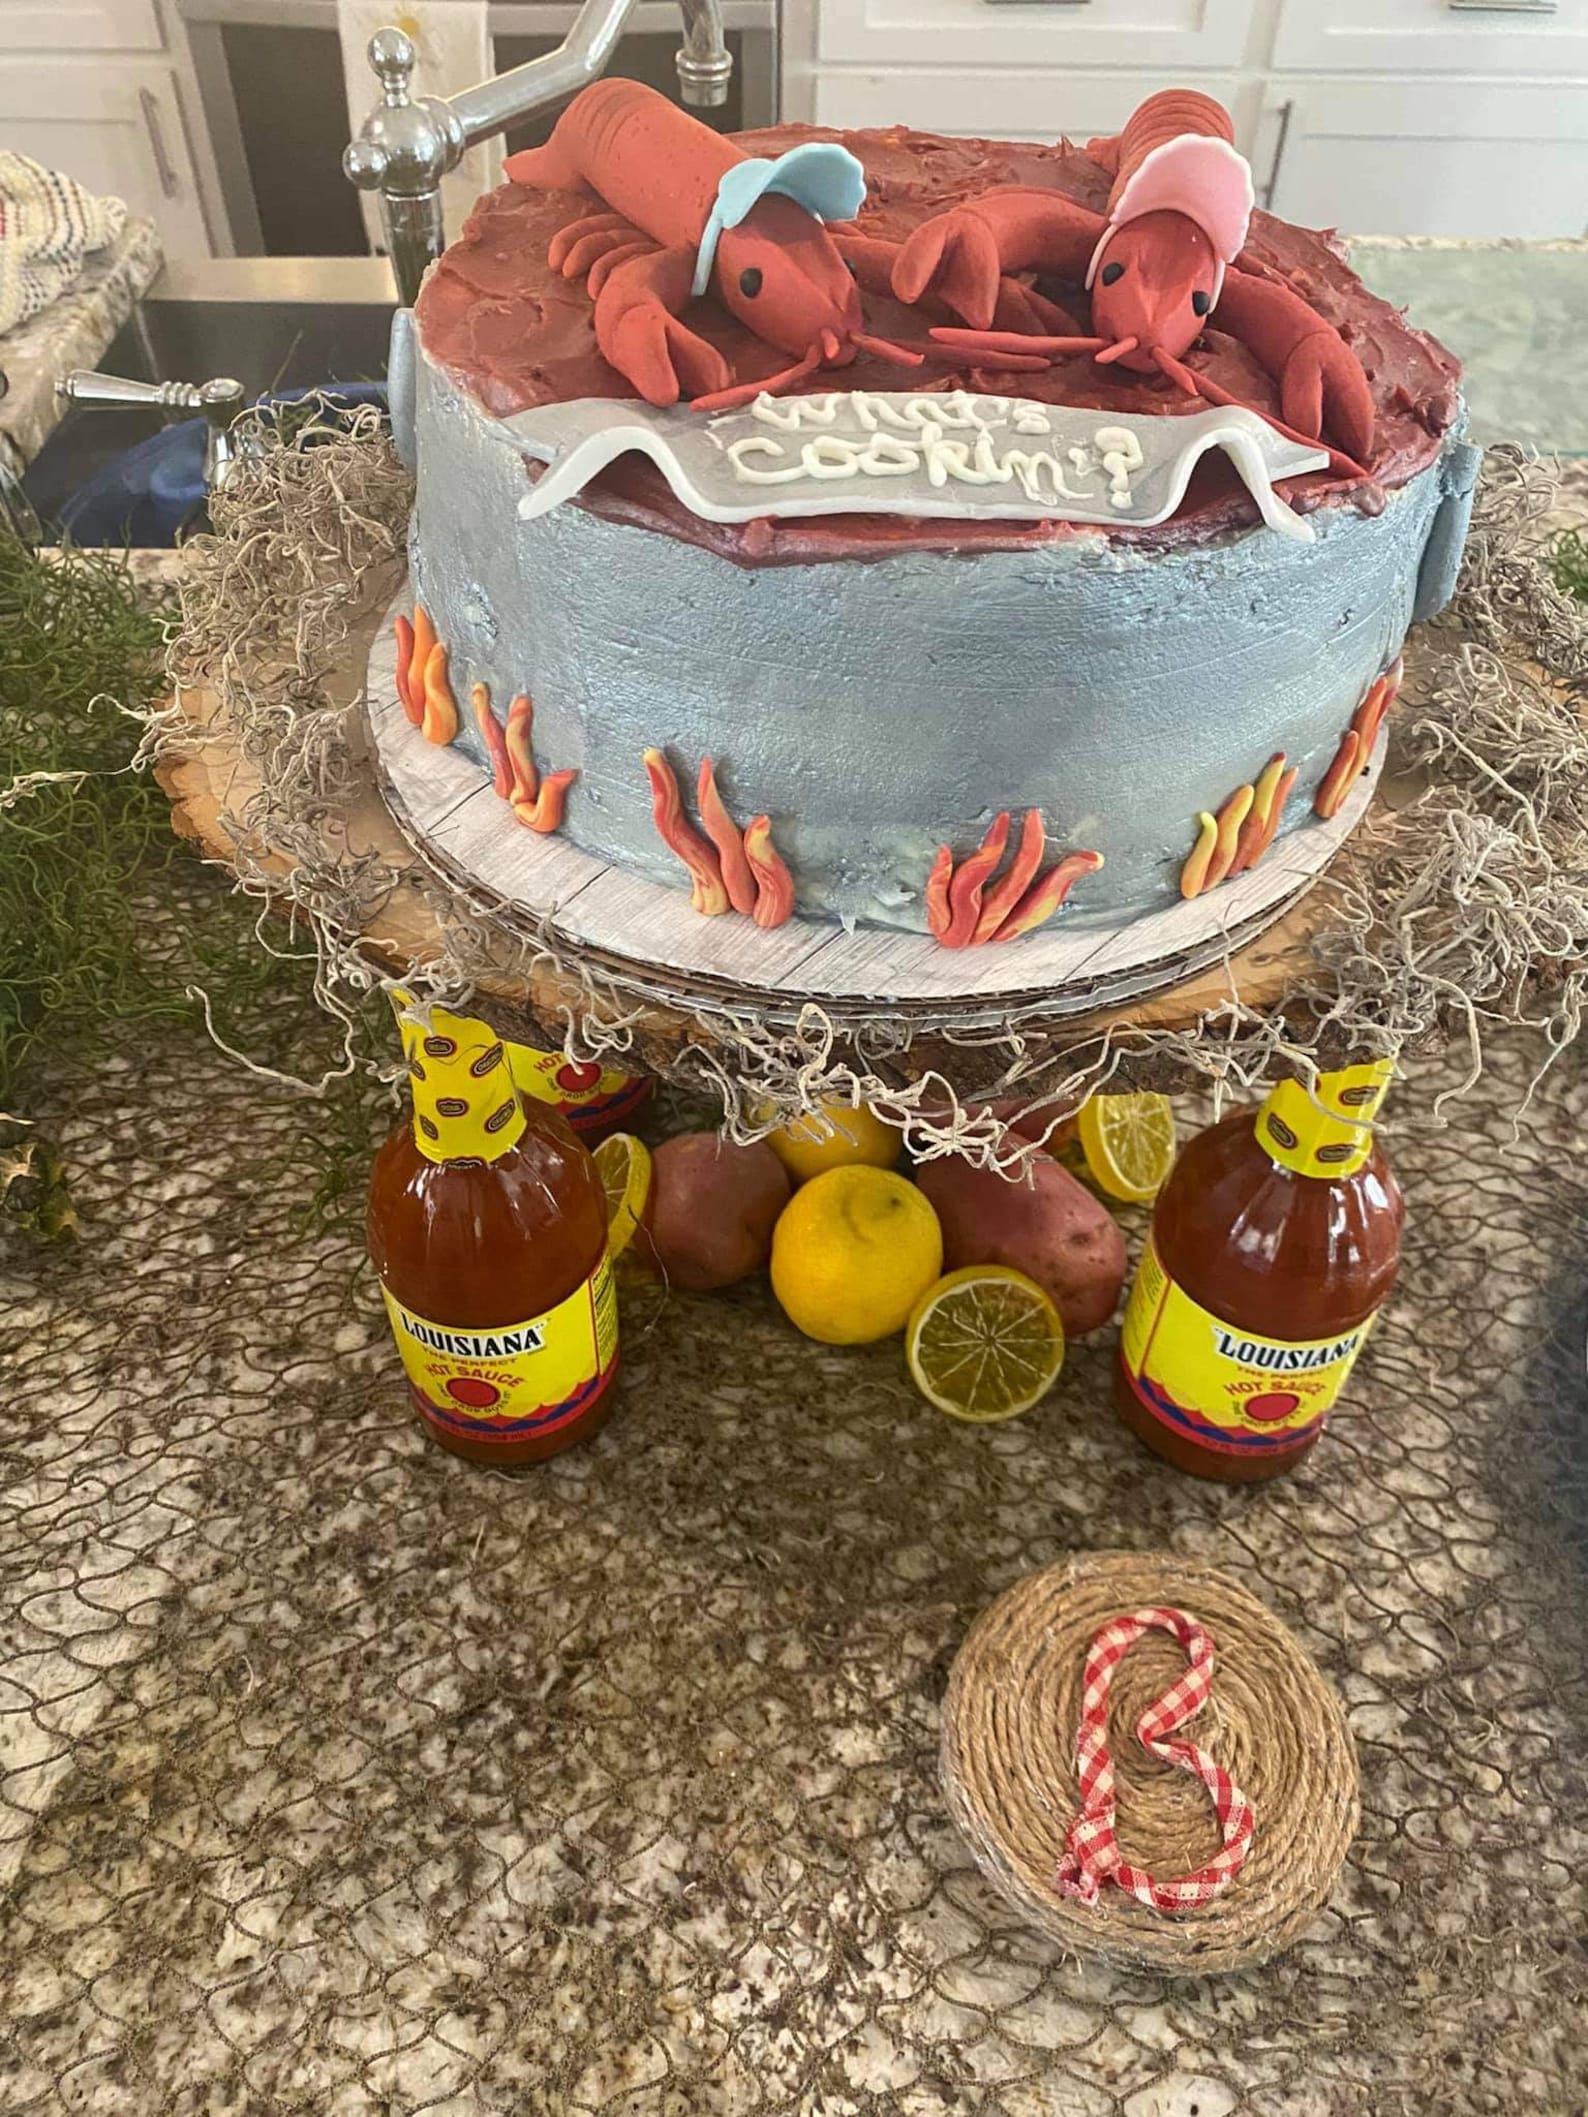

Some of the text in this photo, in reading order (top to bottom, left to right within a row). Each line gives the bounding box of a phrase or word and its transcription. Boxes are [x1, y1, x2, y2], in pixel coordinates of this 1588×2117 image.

[534, 1053, 562, 1072] HOT
[425, 1363, 525, 1388] HOT SAUCE
[1224, 1382, 1263, 1396] HOT
[1056, 1607, 1255, 1911] B
